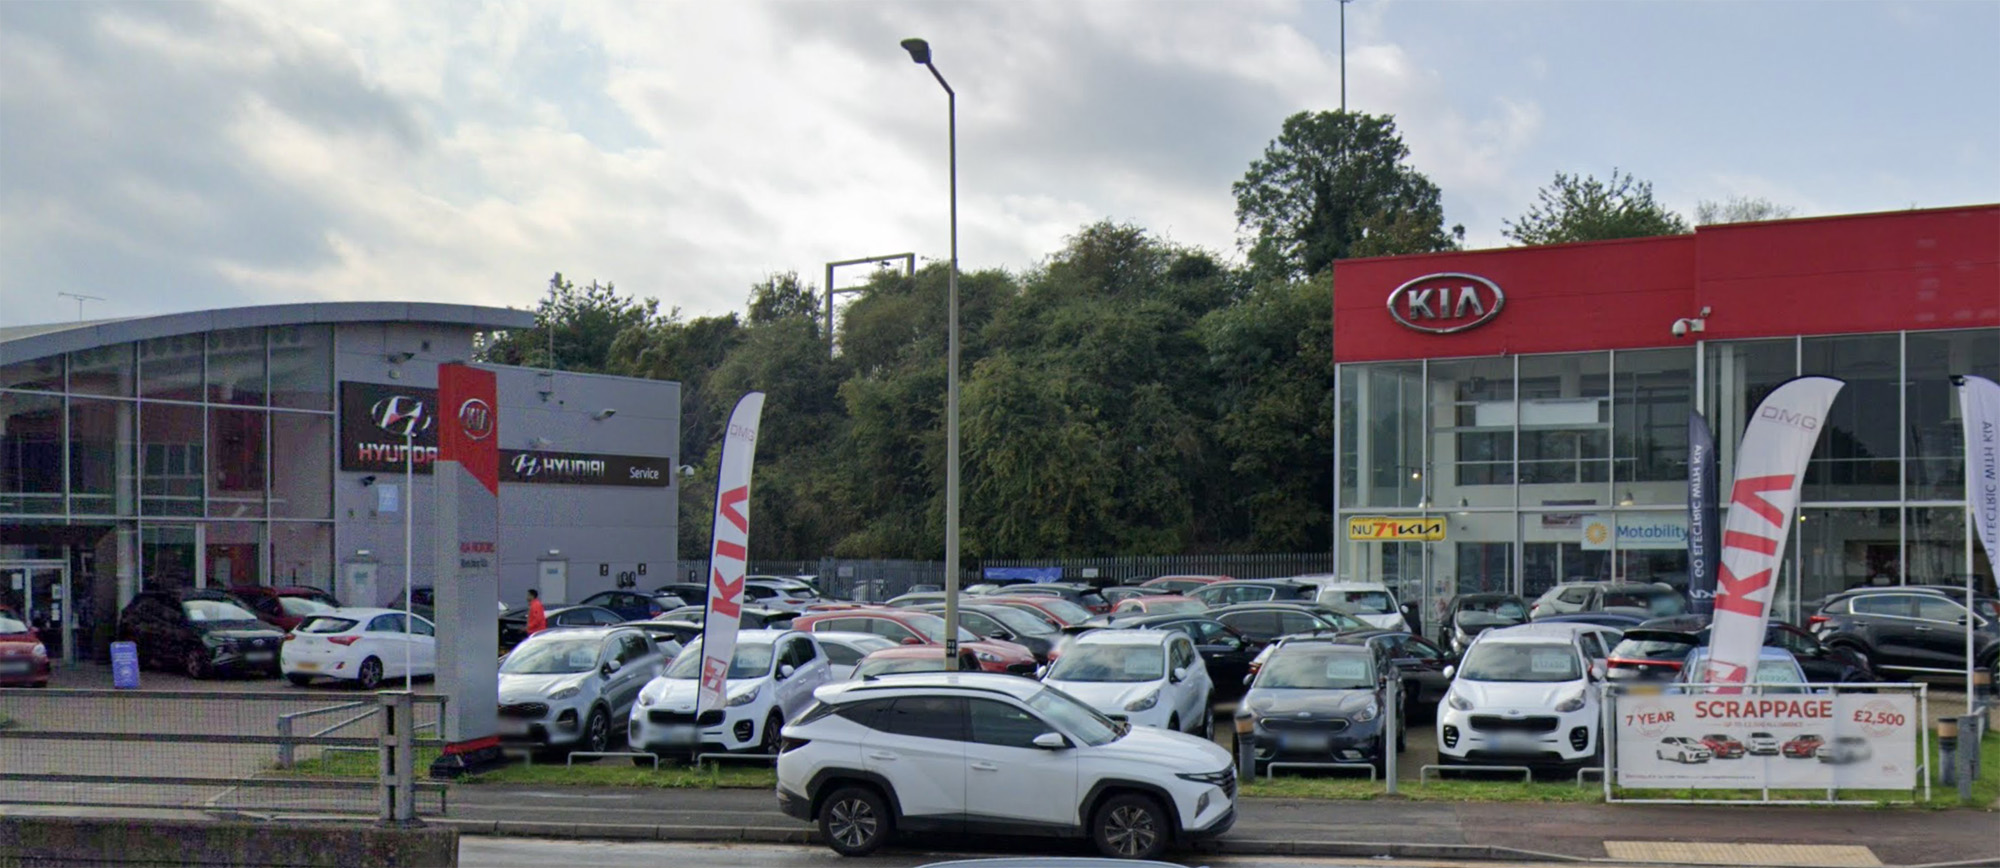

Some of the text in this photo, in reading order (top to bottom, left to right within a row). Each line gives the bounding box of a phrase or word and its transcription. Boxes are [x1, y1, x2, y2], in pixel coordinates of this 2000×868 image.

[1408, 286, 1484, 319] KIA
[1761, 406, 1817, 430] DMG
[730, 424, 755, 441] DMG
[358, 443, 438, 463] HYUNDA
[629, 466, 660, 480] Service
[1615, 523, 1689, 541] Motability
[711, 485, 748, 619] KIA
[1714, 474, 1796, 618] KIA
[1626, 710, 1676, 727] 7 YEAR
[1695, 700, 1833, 719] SCRAPPAGE
[1853, 710, 1906, 727] £2,500
